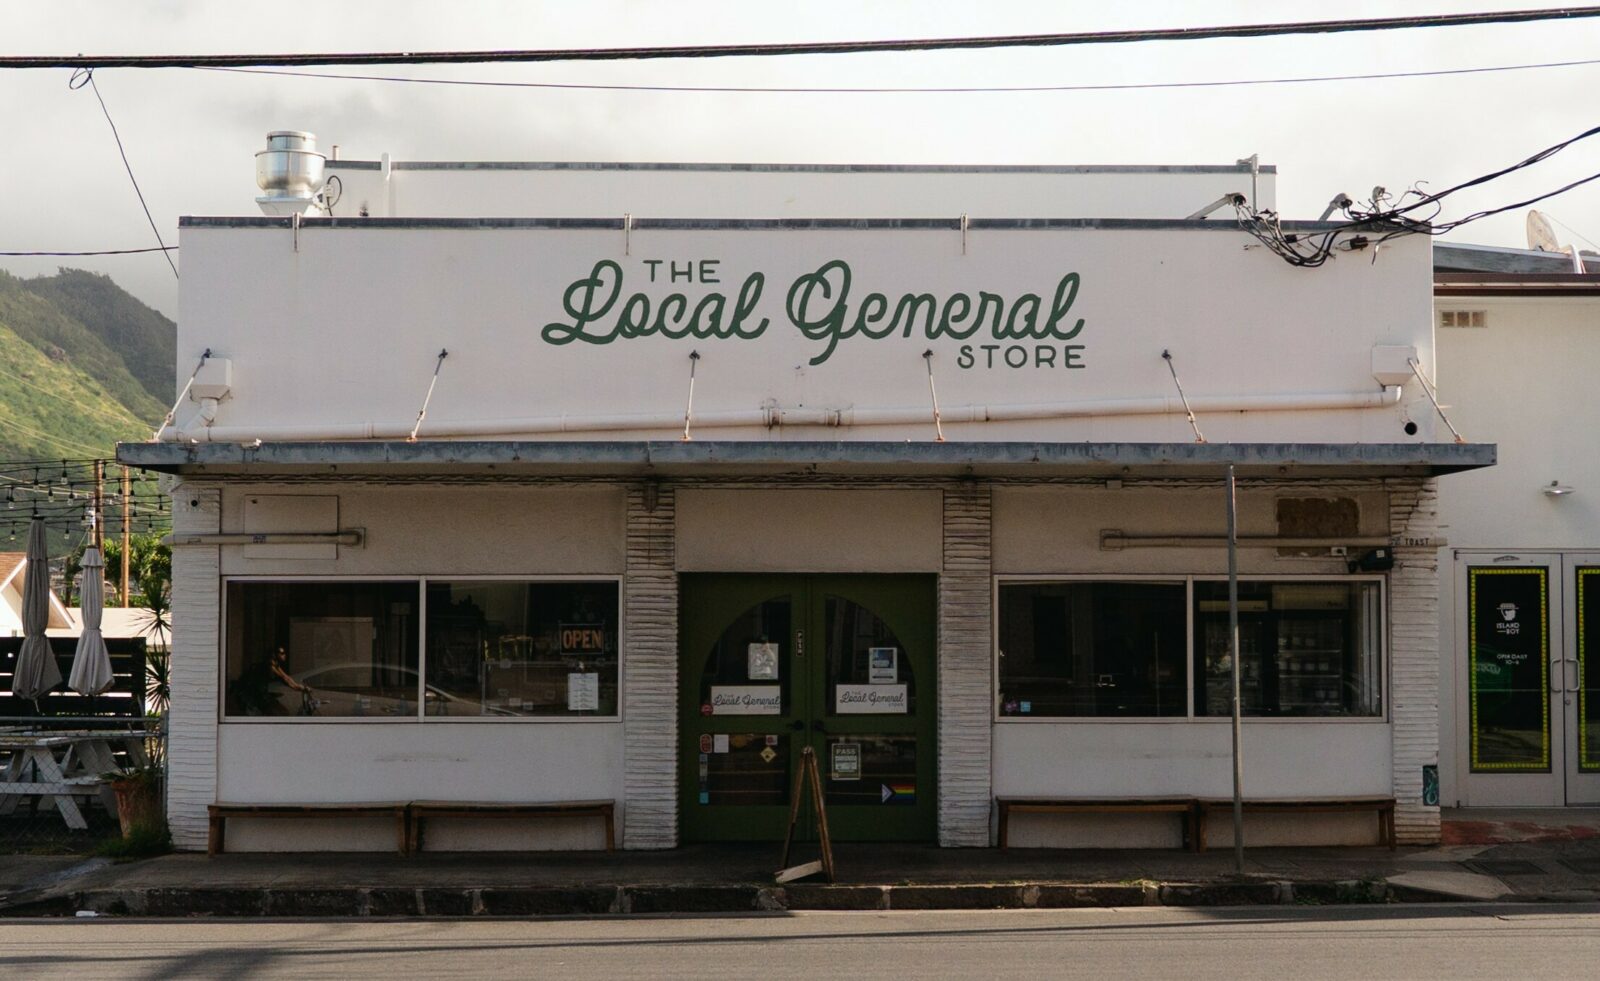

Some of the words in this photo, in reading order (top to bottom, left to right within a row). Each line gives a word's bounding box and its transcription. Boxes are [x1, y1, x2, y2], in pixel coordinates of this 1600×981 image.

[643, 260, 720, 283] THE
[541, 259, 770, 346] Local
[785, 259, 1086, 366] General
[958, 344, 1086, 369] STORE
[1405, 537, 1429, 546] TOAST
[562, 629, 602, 649] OPEN
[713, 694, 741, 706] Local
[742, 694, 780, 709] General
[840, 691, 867, 703] Local
[868, 691, 904, 706] General
